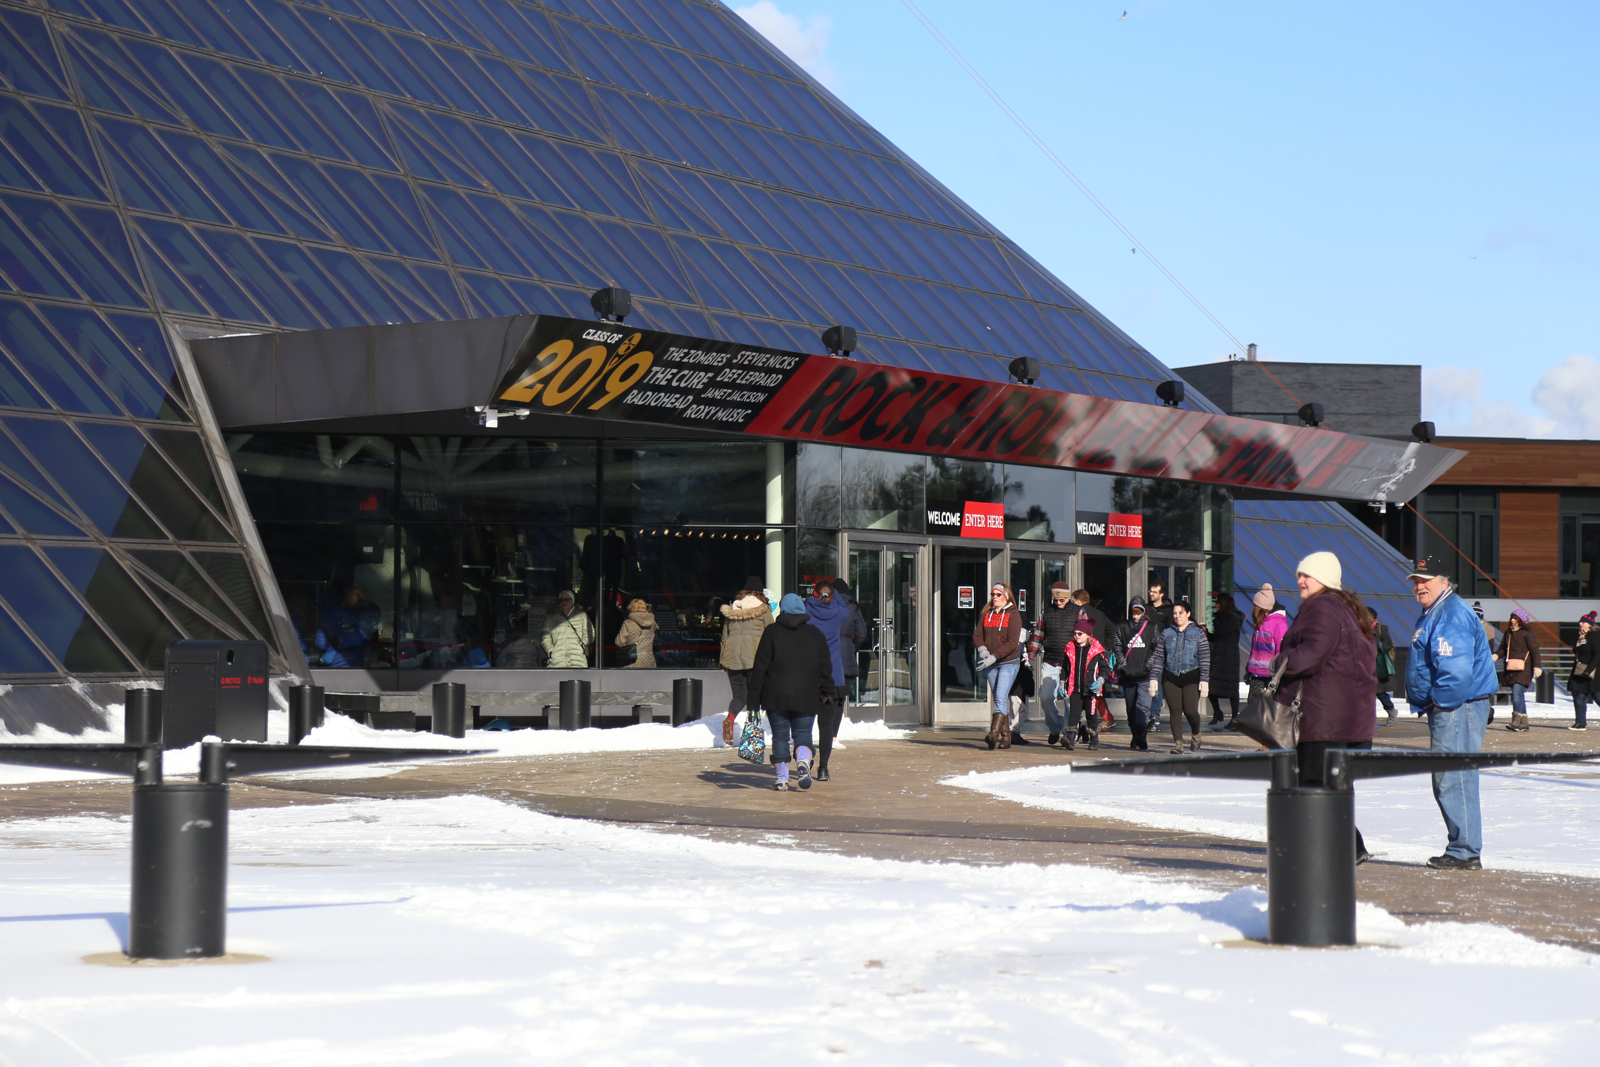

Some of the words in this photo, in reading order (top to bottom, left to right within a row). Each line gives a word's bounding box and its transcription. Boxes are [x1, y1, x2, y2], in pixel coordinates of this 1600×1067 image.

[582, 328, 610, 343] CLASS
[607, 333, 623, 344] OF
[663, 347, 688, 362] THE
[682, 350, 731, 366] ZOMBIES
[733, 350, 769, 366] STEVIE
[765, 355, 799, 370] NICKS
[643, 366, 678, 385] THE
[671, 370, 715, 389] CURE
[716, 369, 740, 382] DEF
[736, 371, 783, 387] LEPPARD
[623, 390, 694, 409] RADIOHEAD
[701, 387, 733, 400] JANET
[727, 390, 768, 403] JACKSON
[683, 405, 719, 419] ROXY
[712, 408, 752, 423] MUSIC
[781, 364, 955, 444] ROCK
[926, 385, 990, 448] &
[963, 391, 1096, 460] ROLL
[1070, 404, 1197, 471] HALL
[1167, 418, 1254, 477] OF
[1216, 427, 1337, 488] FAME
[928, 510, 960, 527] WELCOME
[965, 514, 985, 528] ENTER
[987, 515, 1003, 529] HERE
[1077, 521, 1105, 536] WELCOME
[1109, 524, 1127, 537] ENTER
[1128, 524, 1142, 538] HERE
[1437, 637, 1453, 656] LA
